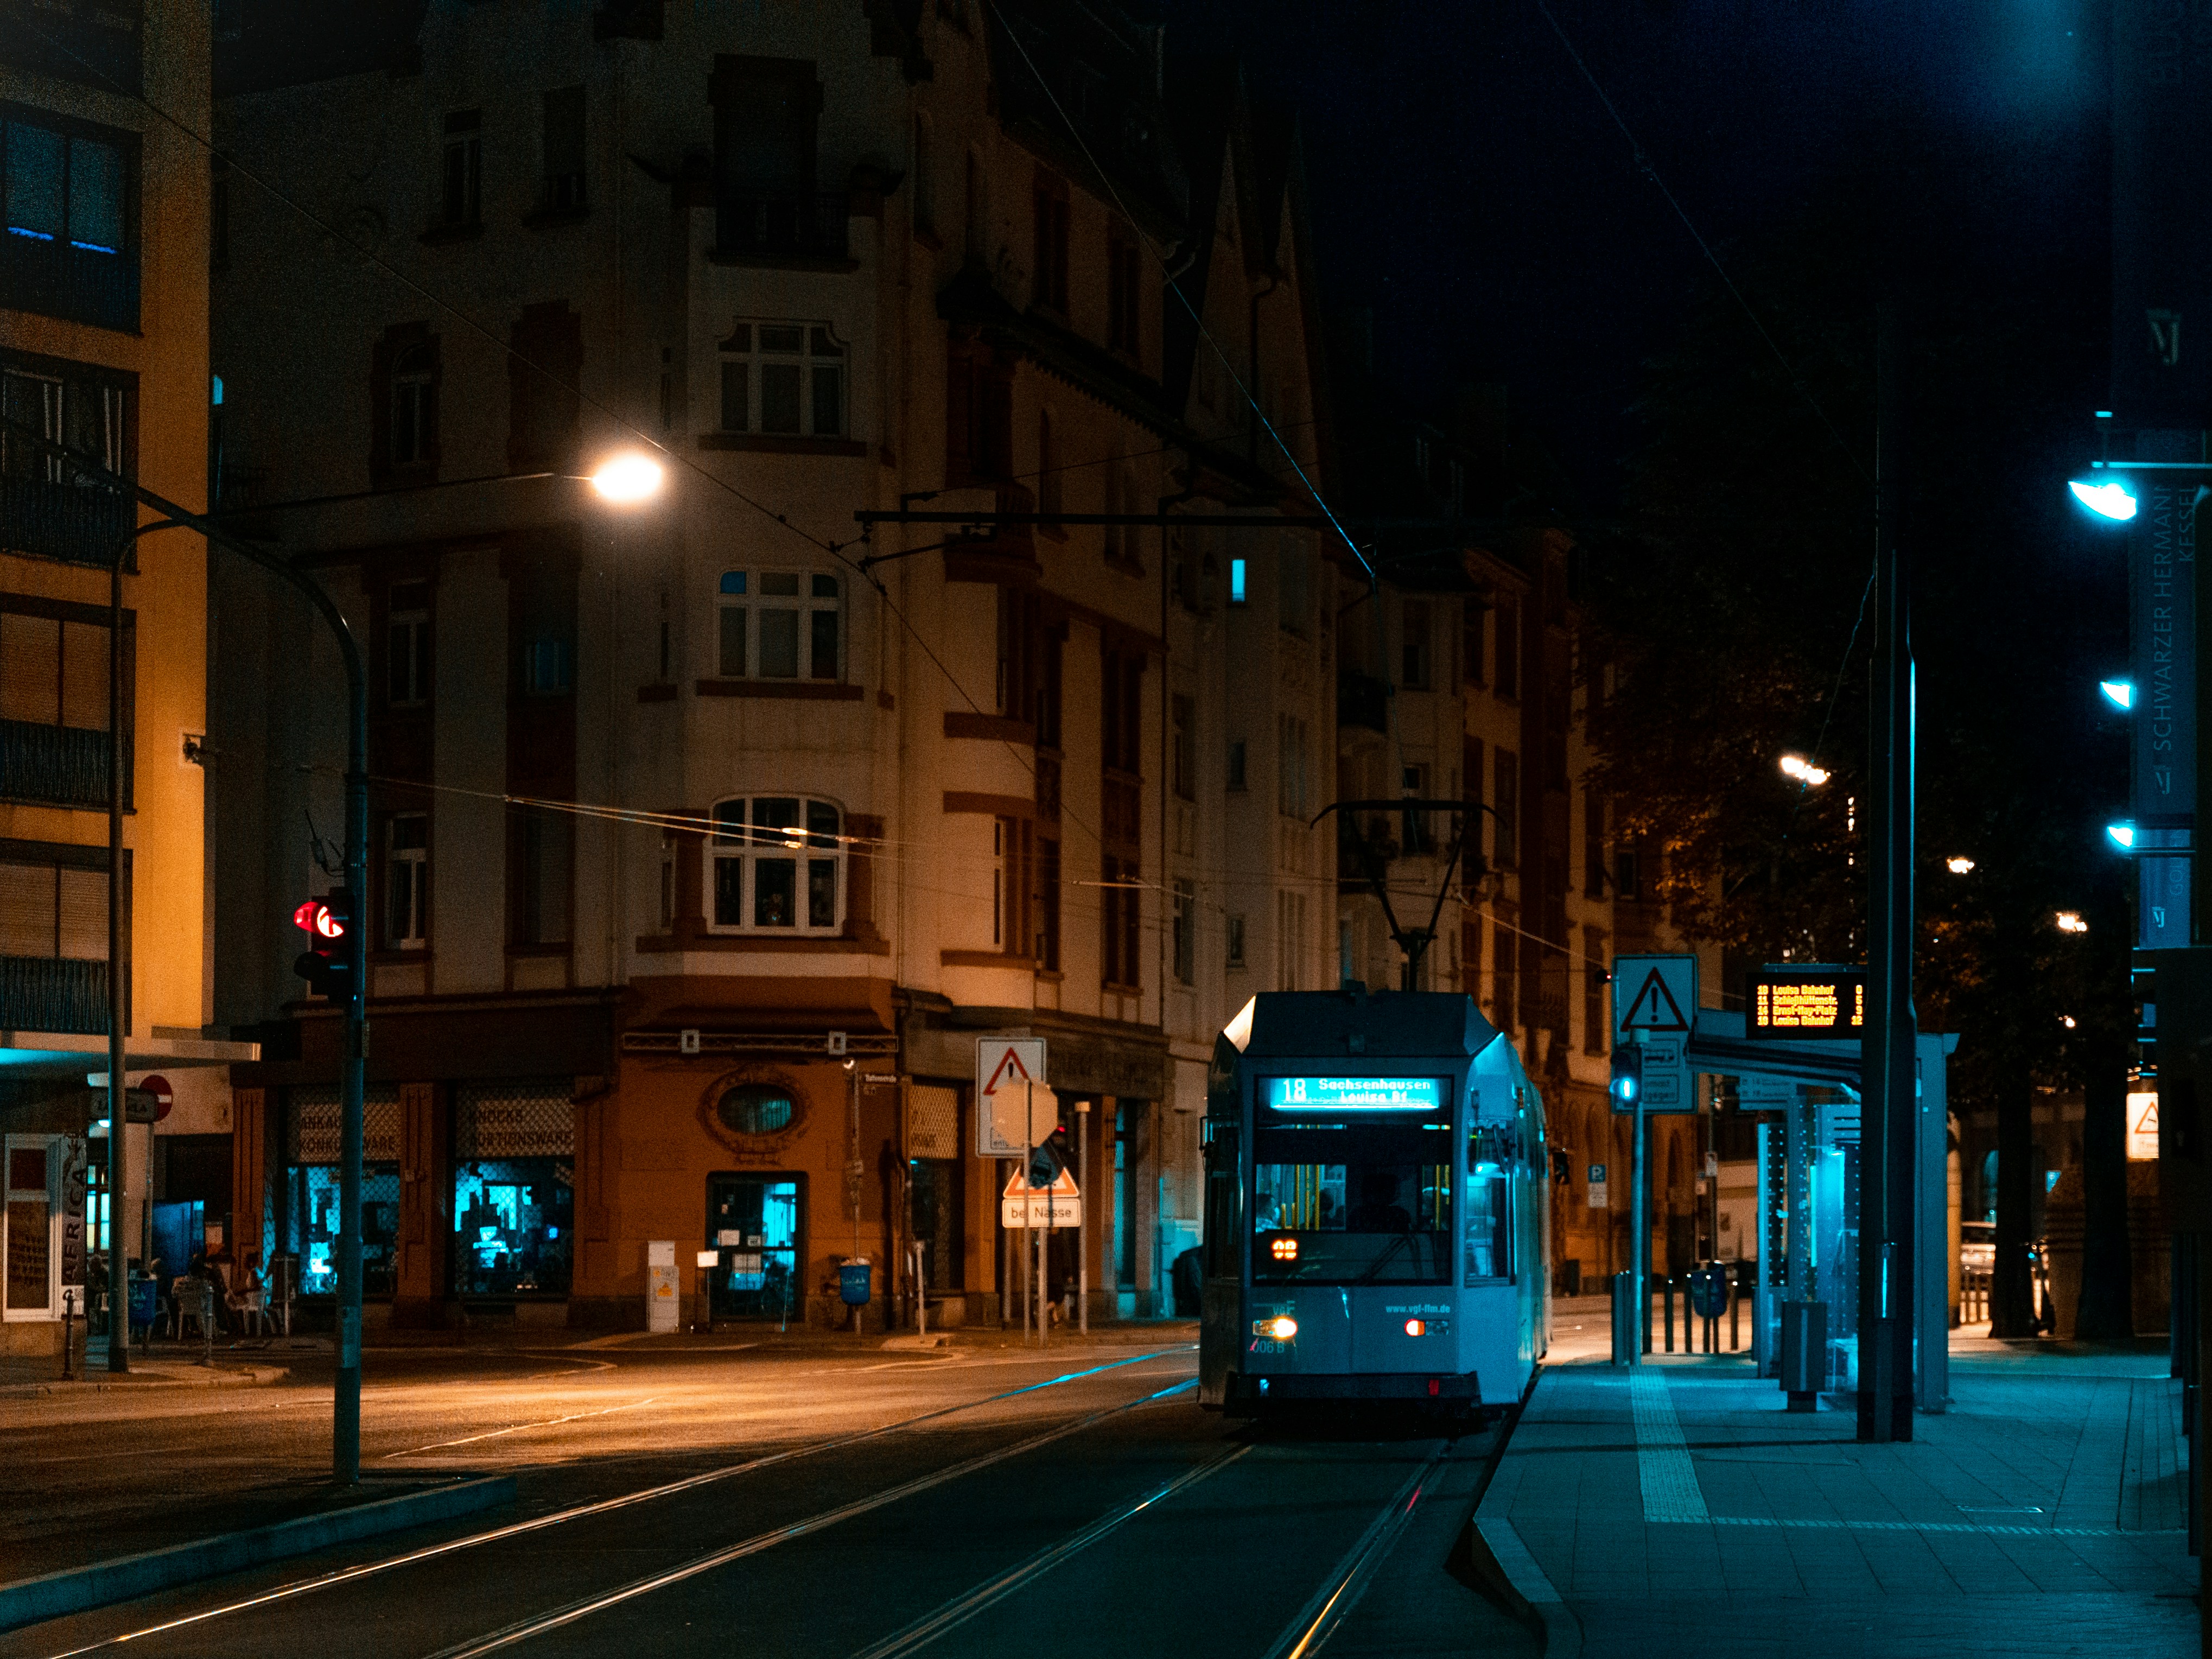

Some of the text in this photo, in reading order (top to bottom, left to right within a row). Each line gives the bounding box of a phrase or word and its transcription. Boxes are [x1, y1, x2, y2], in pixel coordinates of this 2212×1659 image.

[2153, 606, 2172, 752] SCHWARZER
[1772, 985, 1800, 995] Louisa
[1801, 984, 1835, 995] Bahnhof
[1757, 995, 1769, 1006] 11
[1855, 995, 1863, 1005] 5
[1757, 1005, 1769, 1015] 14
[1772, 1006, 1838, 1016] Ernst-May-Platz
[1772, 1015, 1800, 1026] Louisa
[1801, 1015, 1835, 1026] Bahnhof
[1851, 1015, 1863, 1026] 12
[1283, 1078, 1431, 1102] 18 Sachsenhausen
[1340, 1091, 1386, 1103] Louisa
[1011, 1207, 1026, 1218] be
[62, 1168, 87, 1282] AFRICA
[1385, 1304, 1451, 1314] www.vgf-ffm.de
